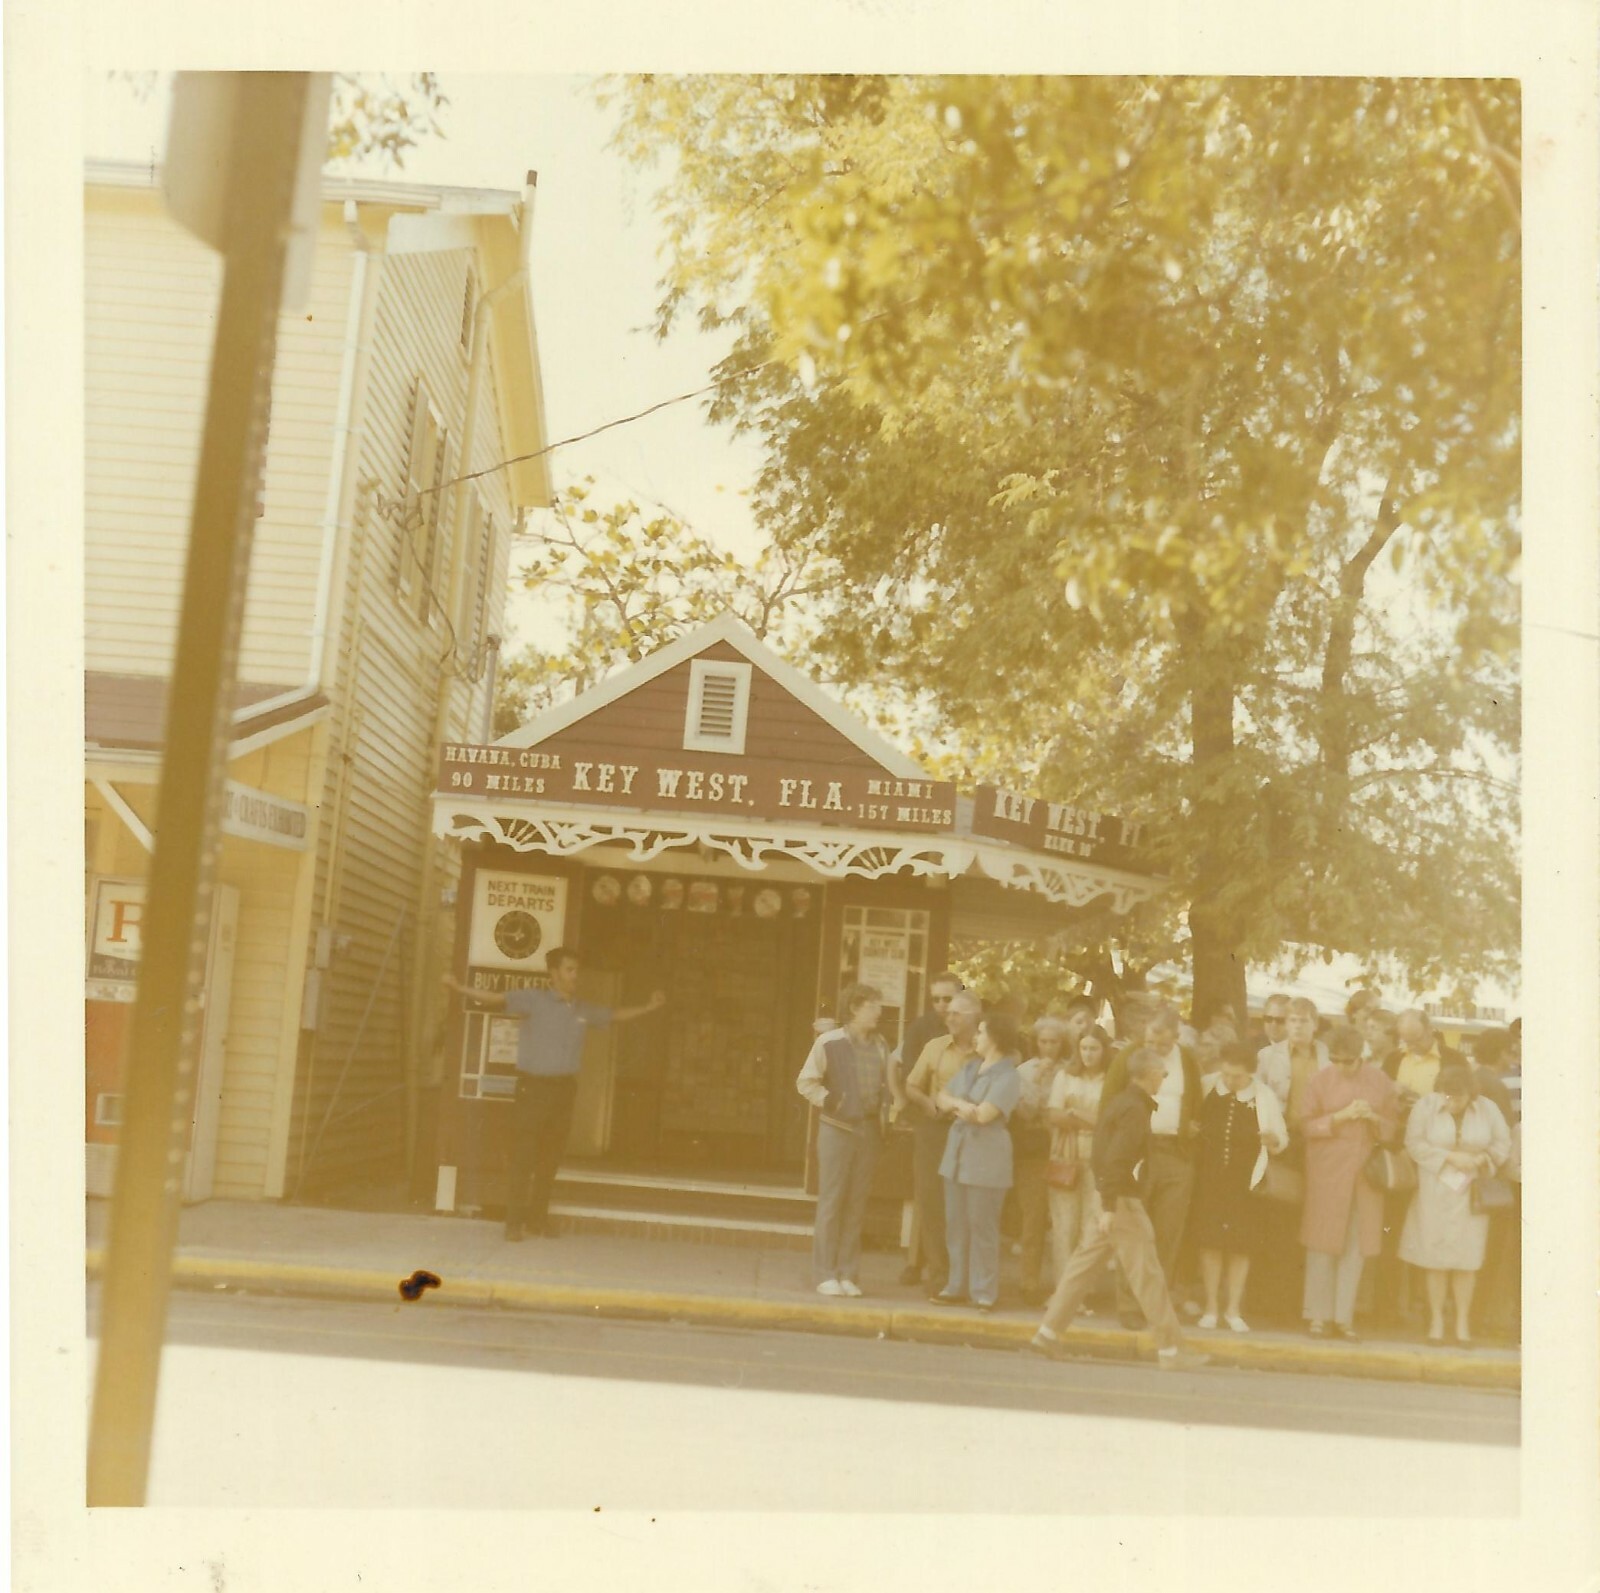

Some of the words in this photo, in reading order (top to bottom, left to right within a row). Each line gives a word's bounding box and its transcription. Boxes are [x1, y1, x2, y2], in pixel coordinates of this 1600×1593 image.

[519, 752, 562, 770] CUBA
[452, 771, 473, 788] 90
[486, 774, 545, 794] MILES
[572, 762, 640, 794] KEY
[778, 778, 853, 811] FLA.
[870, 780, 932, 799] MIAMI
[858, 803, 888, 820] 157
[896, 807, 952, 825] MILES
[993, 789, 1036, 825] KEY
[487, 880, 518, 893] NEXT
[522, 882, 556, 897] TRAIN
[487, 893, 555, 912] DEPARTS
[474, 972, 500, 991] BUY
